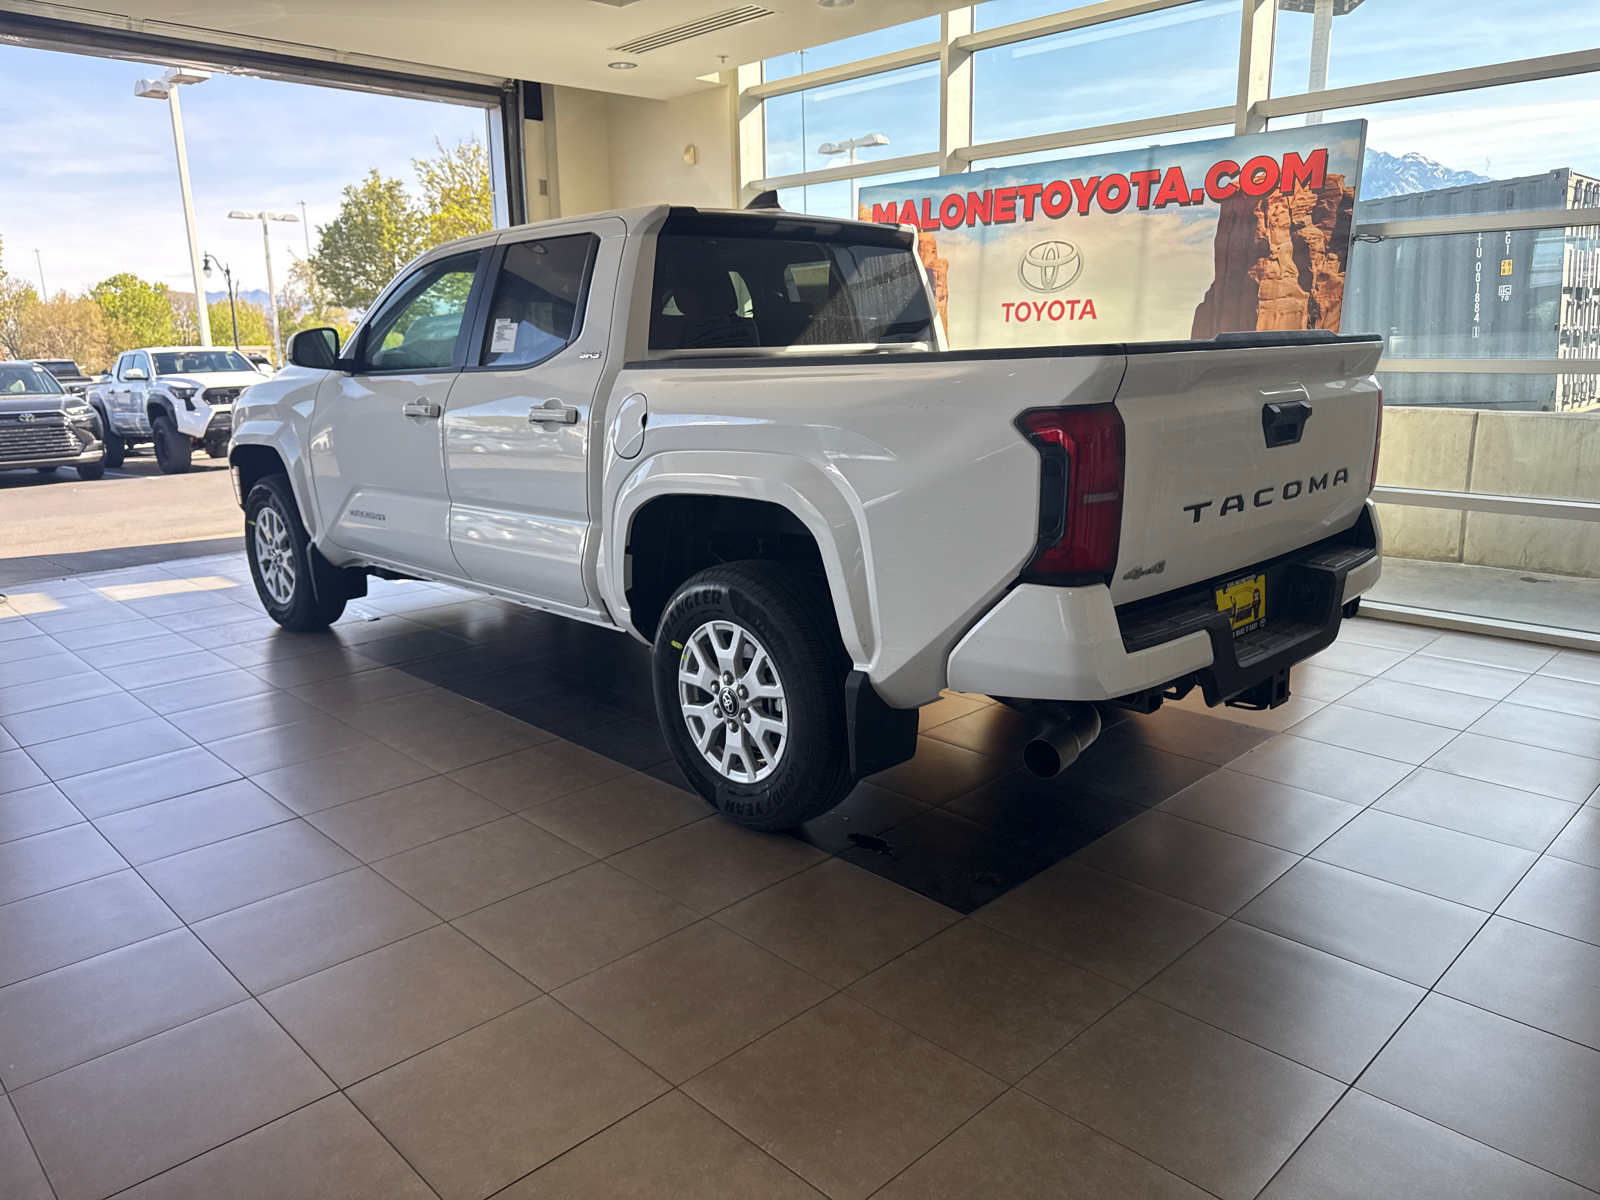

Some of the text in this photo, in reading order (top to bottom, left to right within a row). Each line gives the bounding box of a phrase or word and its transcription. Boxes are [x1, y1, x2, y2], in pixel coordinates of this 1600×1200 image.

[872, 148, 1329, 231] MALONETOYOTA.COM
[1002, 299, 1097, 323] TOYOTA
[1182, 466, 1349, 524] TACOMA
